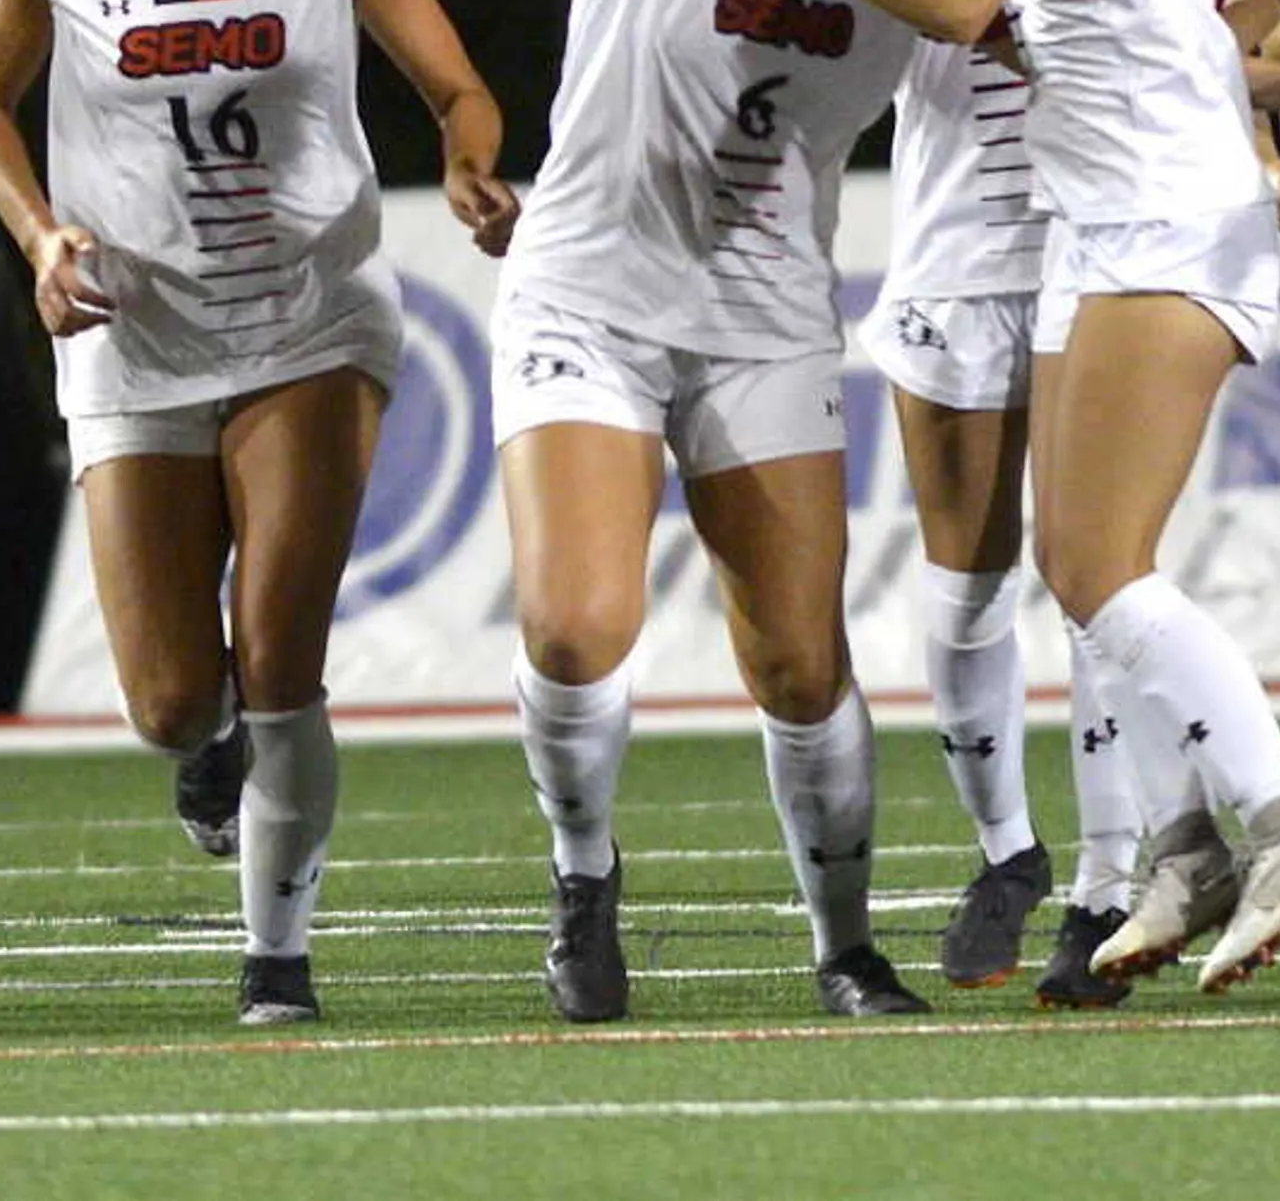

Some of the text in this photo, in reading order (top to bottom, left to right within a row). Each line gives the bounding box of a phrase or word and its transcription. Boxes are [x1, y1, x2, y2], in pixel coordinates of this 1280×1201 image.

[119, 12, 286, 78] SEMO
[166, 89, 260, 162] 16
[737, 75, 790, 140] 6
